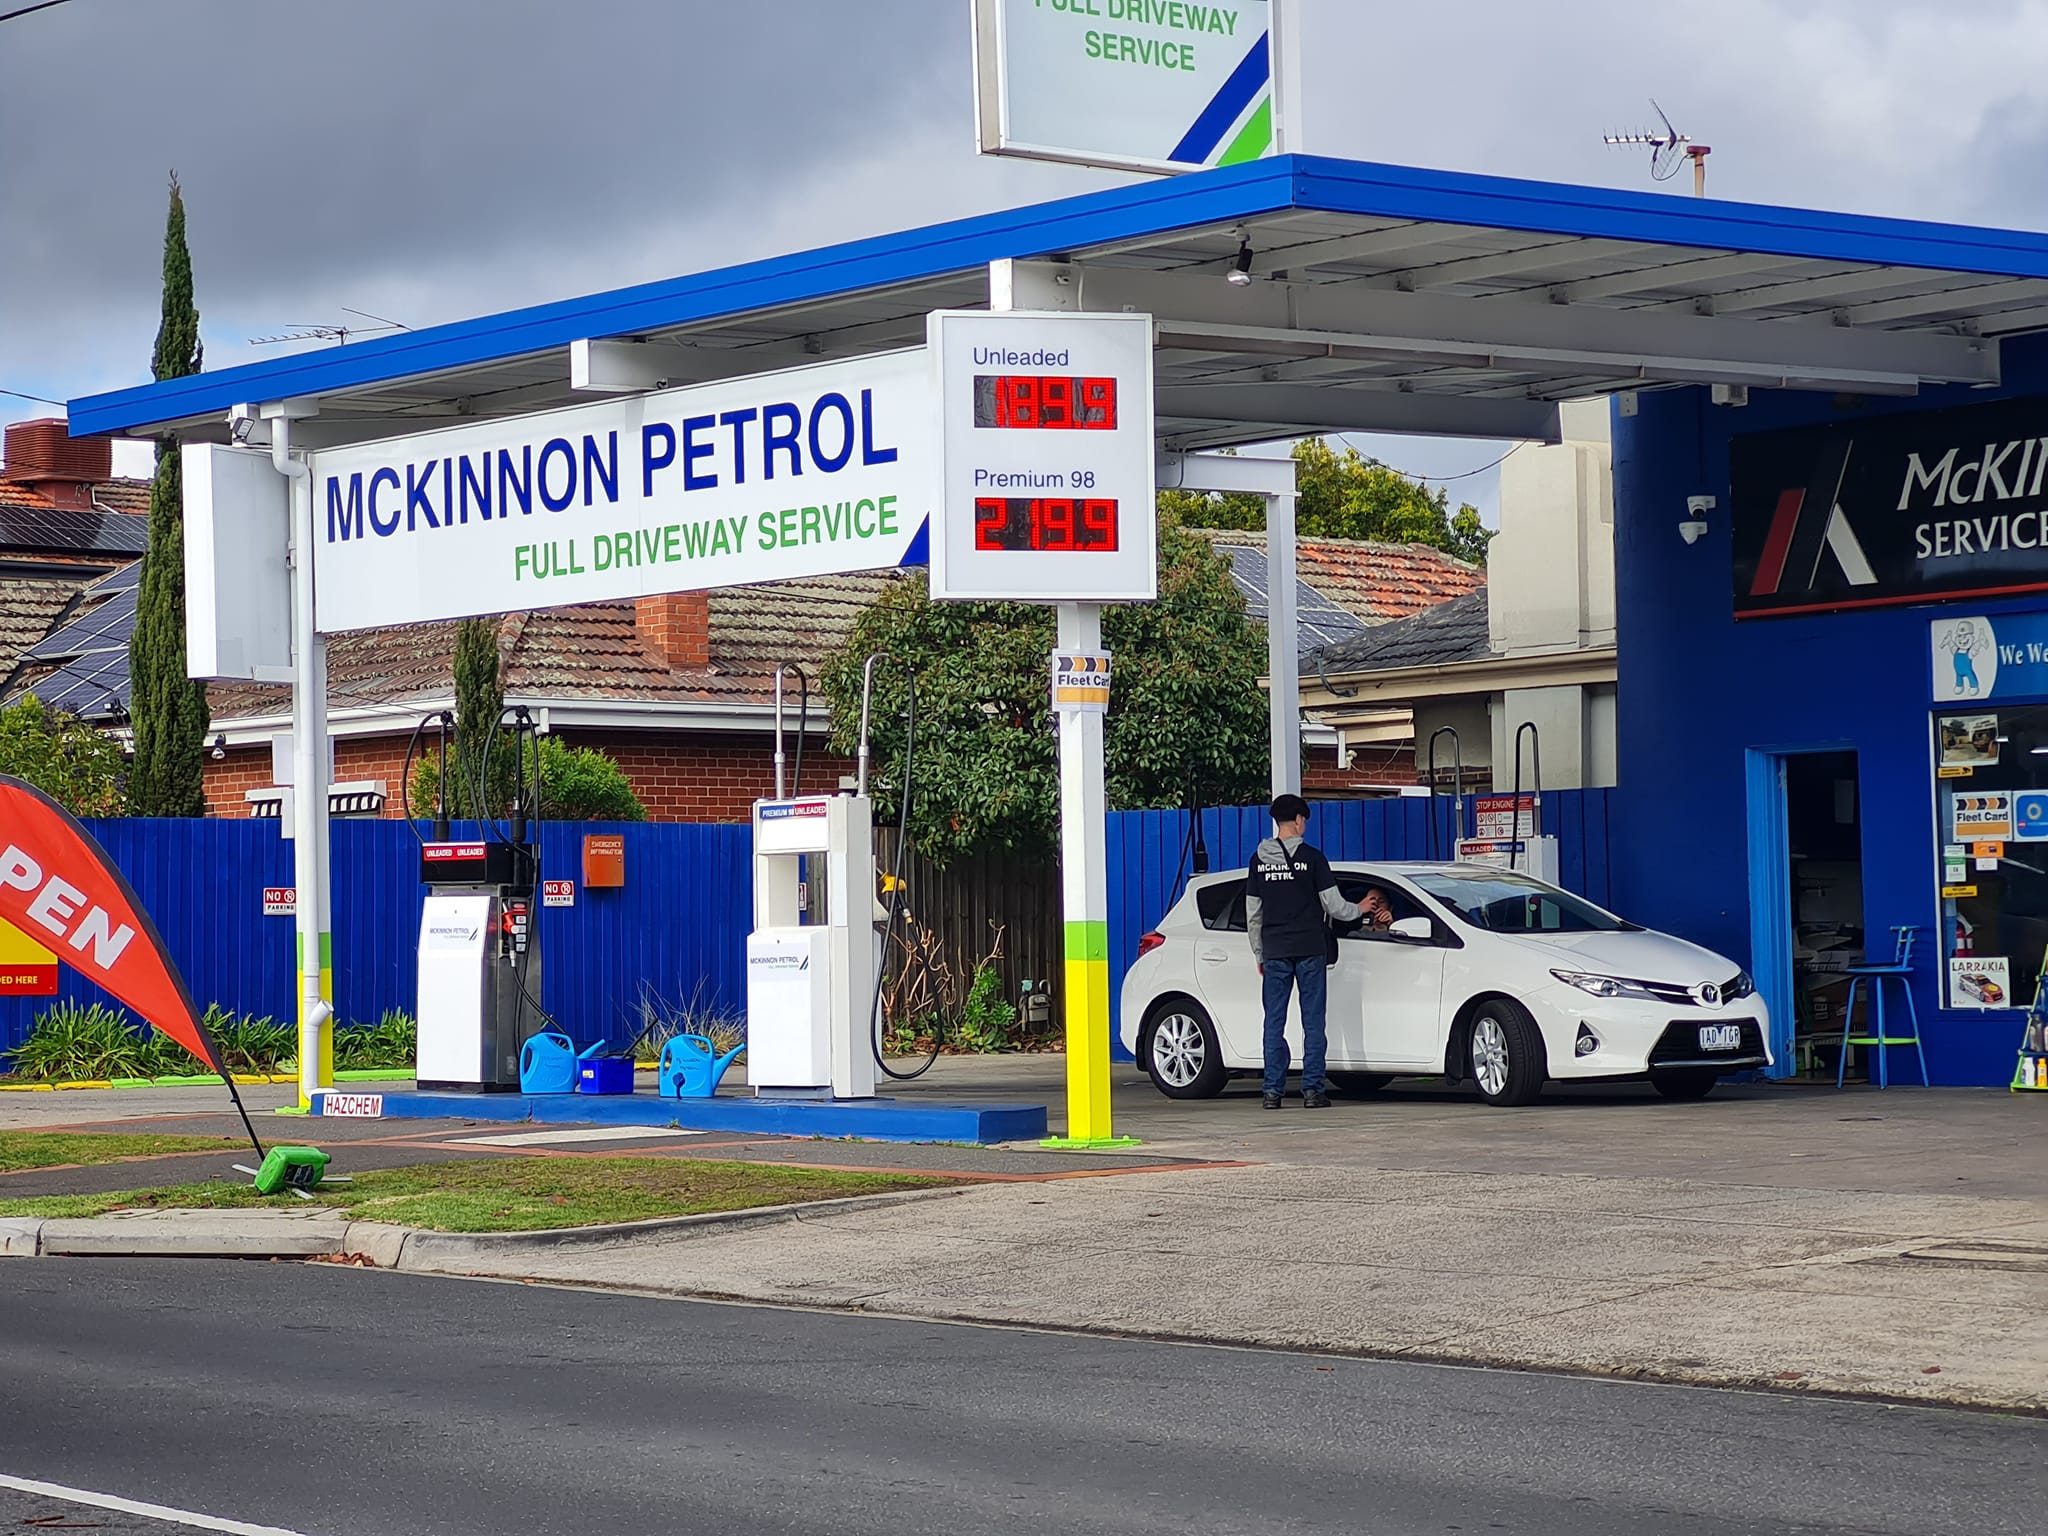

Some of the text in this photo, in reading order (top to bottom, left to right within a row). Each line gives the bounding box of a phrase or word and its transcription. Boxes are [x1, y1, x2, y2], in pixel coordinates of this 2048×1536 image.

[1034, 0, 1239, 36] LL DRIVEWAY
[1085, 30, 1196, 71] SERVICE
[973, 348, 1069, 367] Unleaded
[326, 388, 898, 543] MCKINNON PETROL
[974, 469, 1096, 489] Premium 98
[515, 494, 899, 582] FULL DRIVEWAY SERVICE
[1999, 644, 2024, 665] We
[1058, 674, 1110, 687] Fleet Ca
[795, 805, 826, 816] UNLEADED
[1476, 800, 1491, 810] STOP
[1492, 799, 1515, 809] ENGINE
[1956, 811, 2009, 822] Fleet Card
[427, 847, 484, 858] UNLEADED UNLEADED
[1461, 844, 1491, 854] UNLEADED
[1491, 843, 1513, 852] PREMIU
[1257, 862, 1308, 873] MCKINON
[545, 883, 559, 894] NO
[266, 891, 281, 902] NO
[0, 844, 136, 971] PEN
[750, 955, 800, 964] MCKINNON PETROL
[0, 975, 39, 985] ED HERE
[325, 1096, 380, 1116] HAZCHEM
